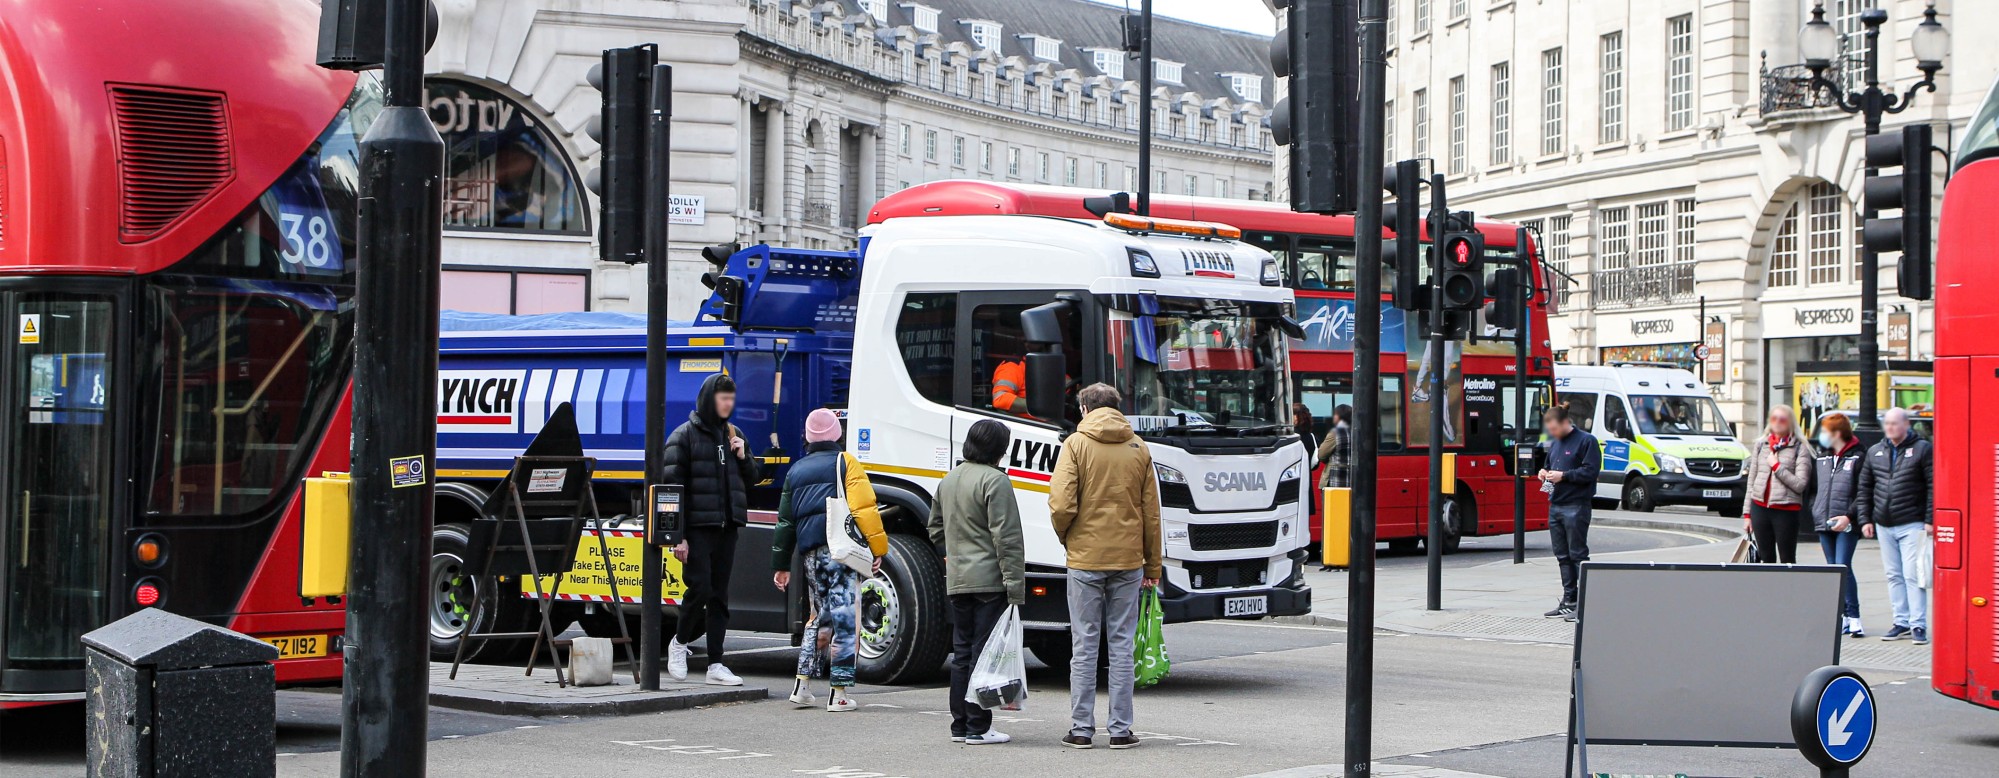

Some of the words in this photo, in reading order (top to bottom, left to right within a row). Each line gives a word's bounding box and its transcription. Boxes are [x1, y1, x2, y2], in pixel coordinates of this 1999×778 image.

[684, 207, 696, 215] W1
[281, 212, 329, 267] 38
[1188, 249, 1235, 272] LYNCH
[1793, 308, 1854, 329] NESPRESSO
[1630, 319, 1675, 338] NESPRESSO
[1463, 378, 1496, 390] Metroline
[441, 378, 518, 413] YNCH
[1204, 472, 1267, 492] SCANIA
[589, 547, 625, 558] PLASE
[573, 560, 592, 570] Take
[594, 561, 617, 571] Exa
[619, 562, 640, 572] Care
[570, 574, 589, 584] Near
[592, 575, 611, 585] This
[1229, 600, 1246, 613] EX21
[292, 637, 318, 655] 1192
